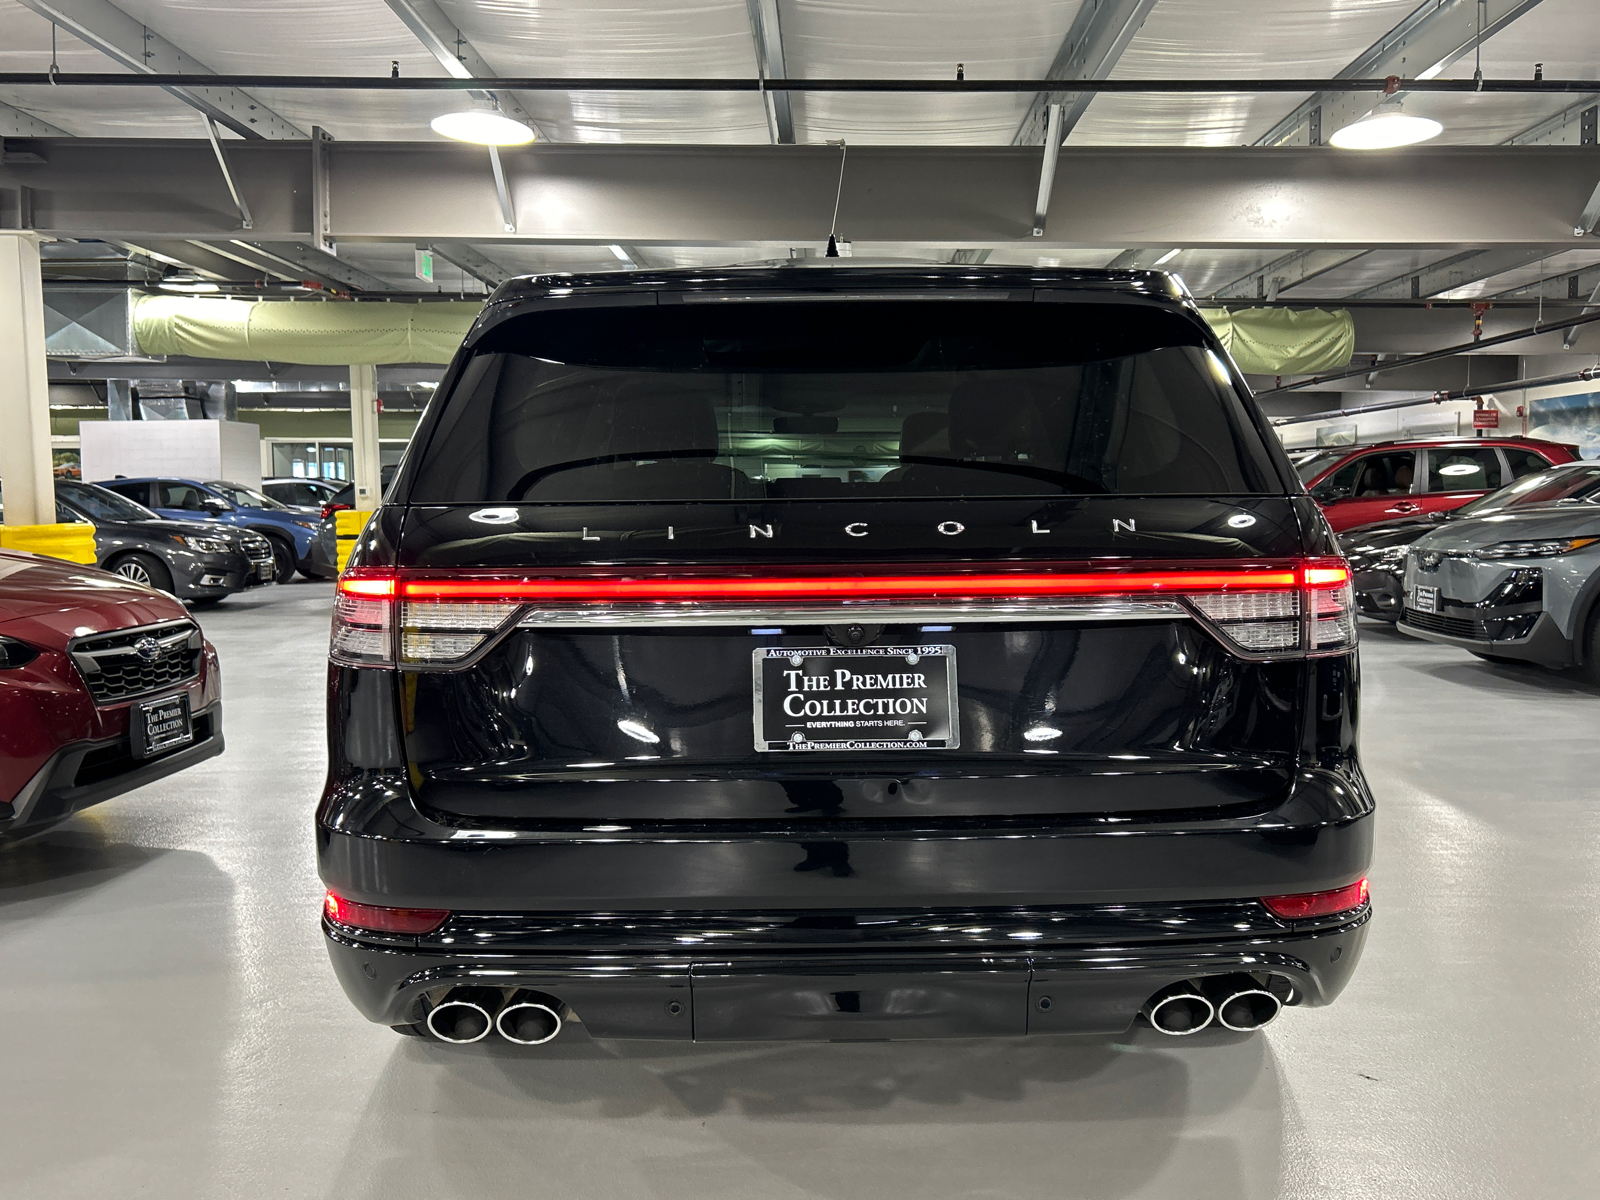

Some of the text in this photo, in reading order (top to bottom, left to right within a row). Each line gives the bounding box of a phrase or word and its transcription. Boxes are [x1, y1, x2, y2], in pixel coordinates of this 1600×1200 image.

[582, 518, 1136, 542] LINCOLN
[768, 646, 941, 657] AUTOMOTIVE EXCELLENCE SINCE 1995
[783, 669, 927, 691] THE PREMIER
[783, 693, 928, 717] COLLECTION
[146, 708, 182, 723] THE PREMIER
[884, 719, 906, 727] HERE.
[148, 718, 183, 735] COLLECTION
[787, 741, 928, 750] THEPREMIERCOLLECTION.COM
